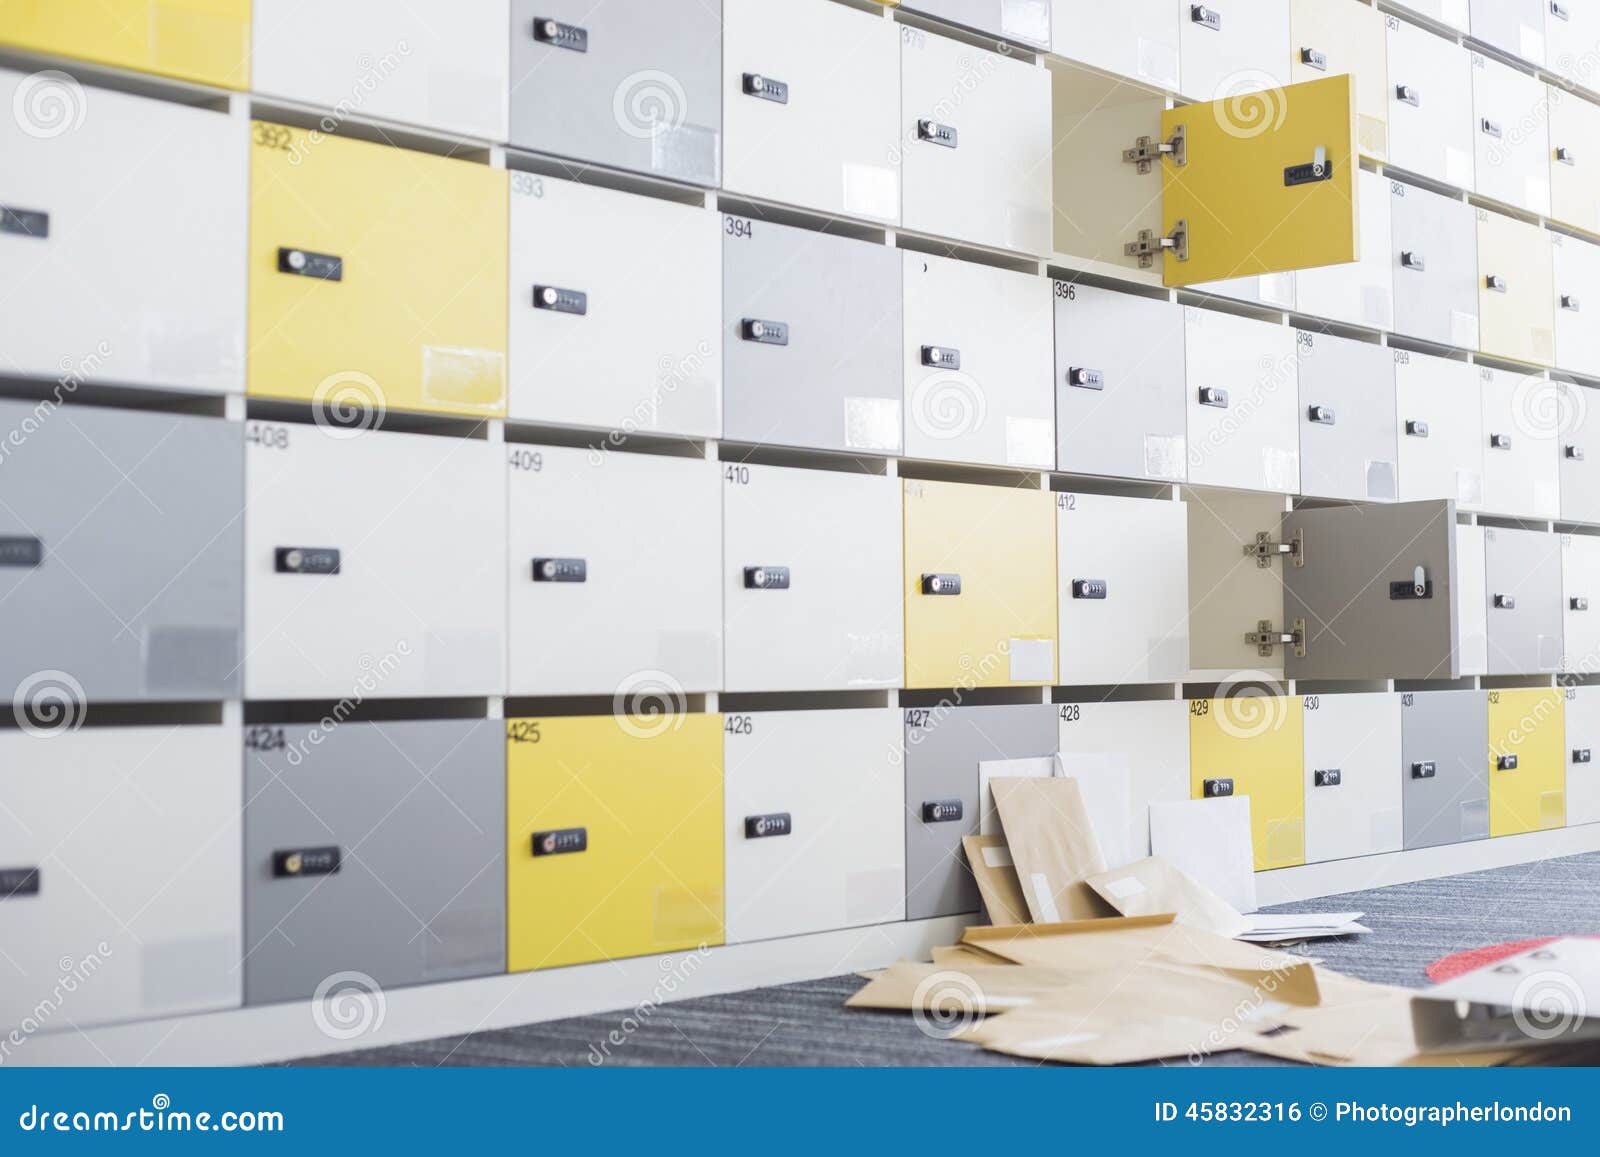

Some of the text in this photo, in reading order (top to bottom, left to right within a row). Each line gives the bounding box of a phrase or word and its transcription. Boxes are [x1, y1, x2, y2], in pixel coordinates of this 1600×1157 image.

[1386, 15, 1400, 32] 367
[252, 121, 292, 151] 392
[511, 174, 545, 199] 393
[1391, 181, 1405, 198] 383
[725, 216, 753, 239] 394
[1055, 281, 1076, 301] 396
[1297, 331, 1313, 347] 398
[1394, 350, 1409, 365] 399
[245, 425, 288, 449] 408
[508, 449, 543, 472] 409
[725, 465, 749, 485] 410
[1057, 493, 1076, 511] 412
[1304, 695, 1320, 710] 430
[1401, 693, 1414, 708] 431
[1487, 691, 1500, 704] 432
[1060, 704, 1080, 721] 428
[1191, 699, 1209, 716] 429
[725, 715, 753, 735] 426
[906, 709, 930, 728] 427
[244, 728, 286, 751] 424
[507, 721, 541, 743] 425
